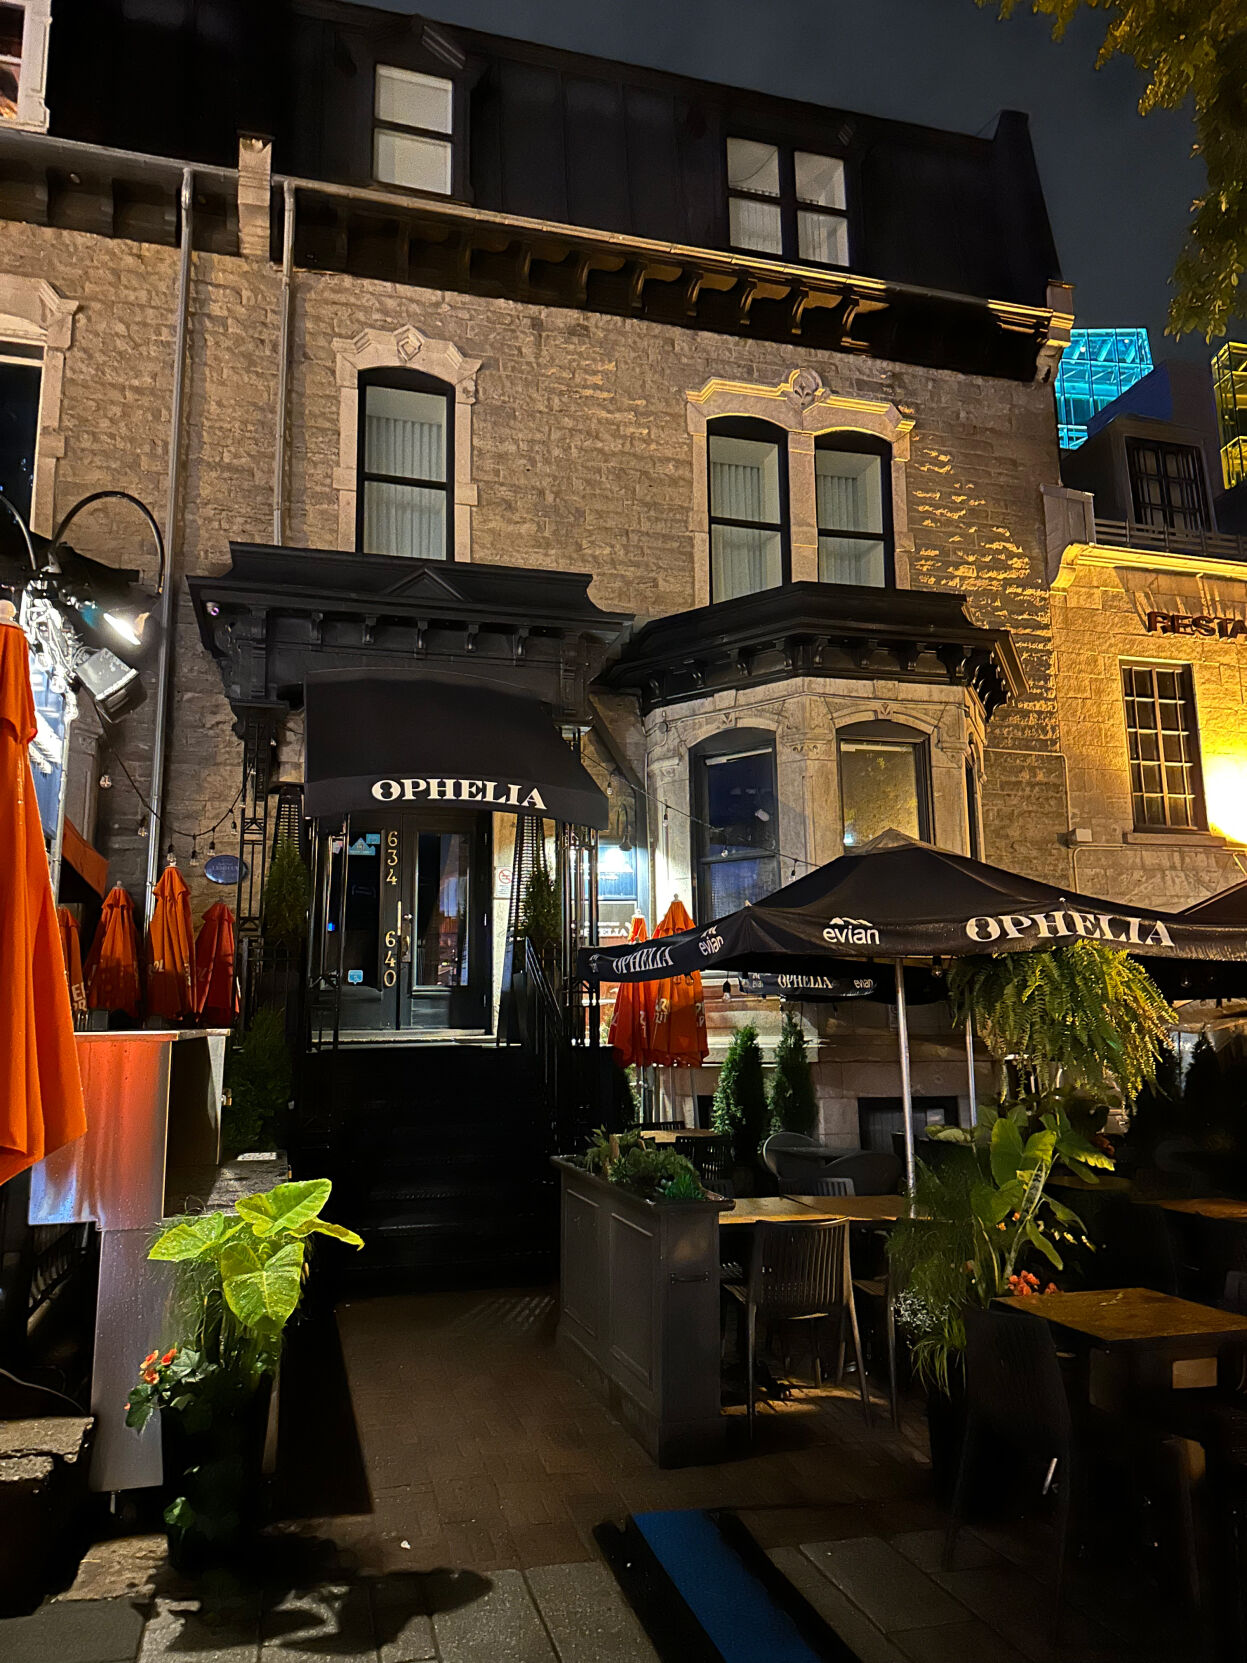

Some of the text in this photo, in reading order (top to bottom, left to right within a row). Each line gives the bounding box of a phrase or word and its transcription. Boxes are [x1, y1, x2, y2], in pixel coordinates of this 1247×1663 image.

[371, 778, 547, 809] OPHELIA
[386, 831, 398, 885] 634
[822, 926, 880, 944] evian
[966, 911, 1175, 947] OPHELIA
[384, 931, 396, 987] 640
[612, 946, 674, 974] OPHELIA
[699, 936, 724, 956] evian
[778, 974, 833, 989] OPHELIA
